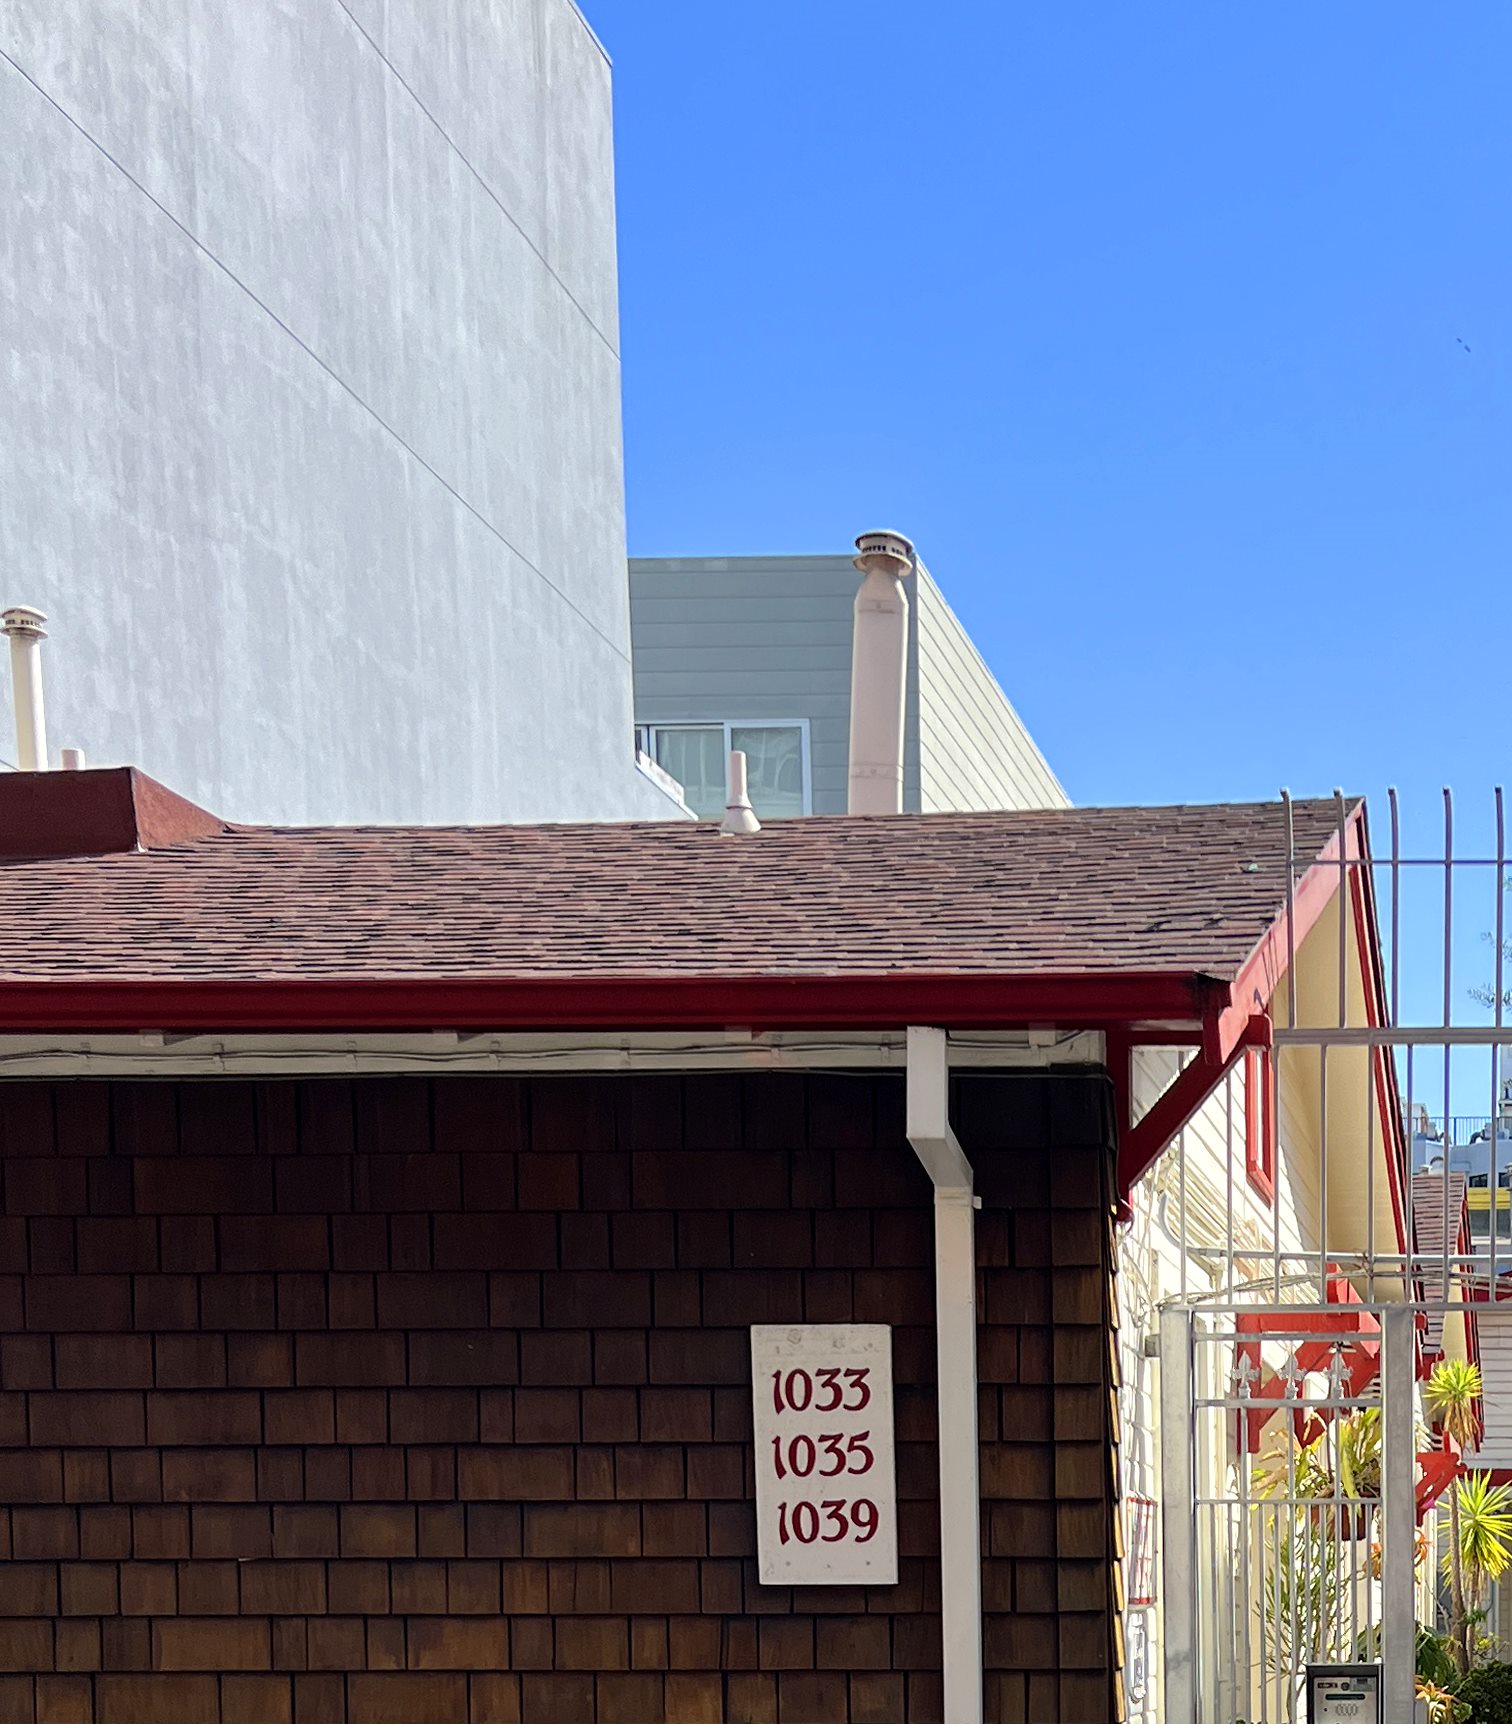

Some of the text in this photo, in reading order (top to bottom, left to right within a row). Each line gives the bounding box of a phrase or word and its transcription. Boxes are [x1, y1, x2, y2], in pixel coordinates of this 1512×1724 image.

[772, 1368, 871, 1414] 1033
[772, 1430, 874, 1480] 1035
[777, 1498, 879, 1545] 1039
